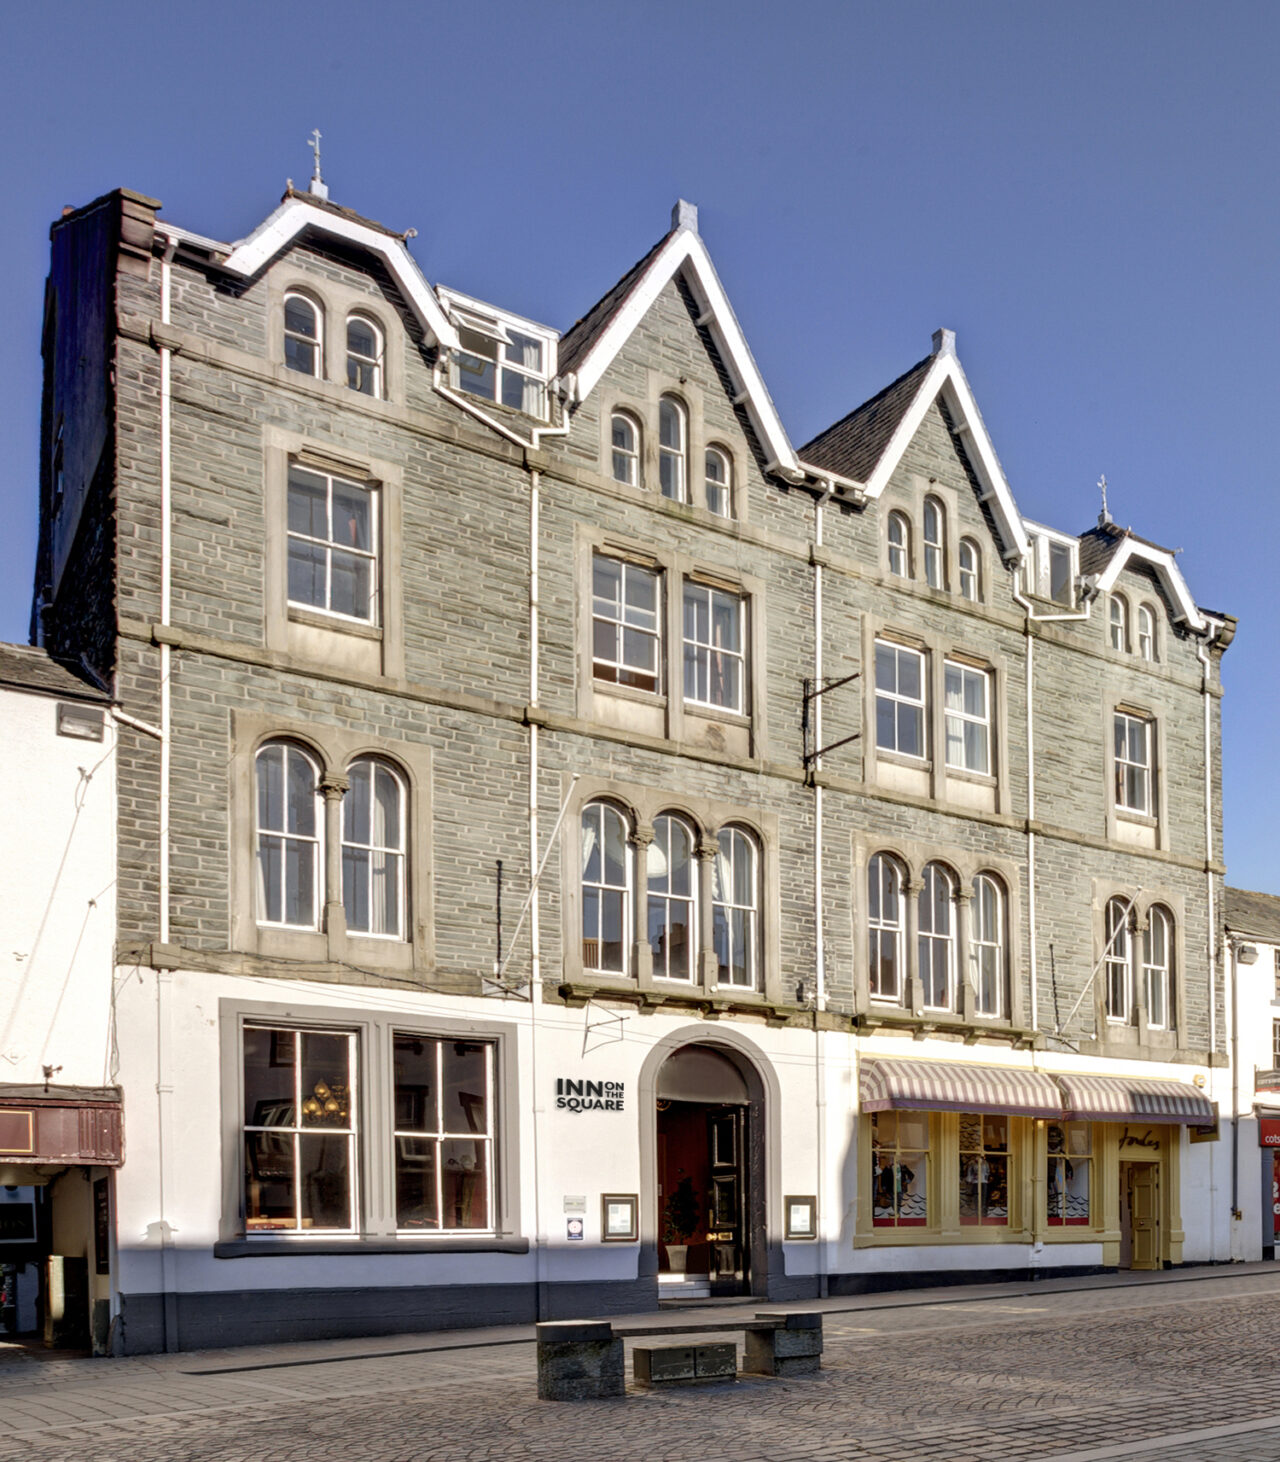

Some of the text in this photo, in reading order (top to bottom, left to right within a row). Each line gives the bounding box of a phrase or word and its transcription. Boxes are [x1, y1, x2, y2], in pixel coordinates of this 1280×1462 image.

[557, 1078, 624, 1097] INN ON
[605, 1090, 624, 1099] THE
[556, 1097, 624, 1113] SQUARE
